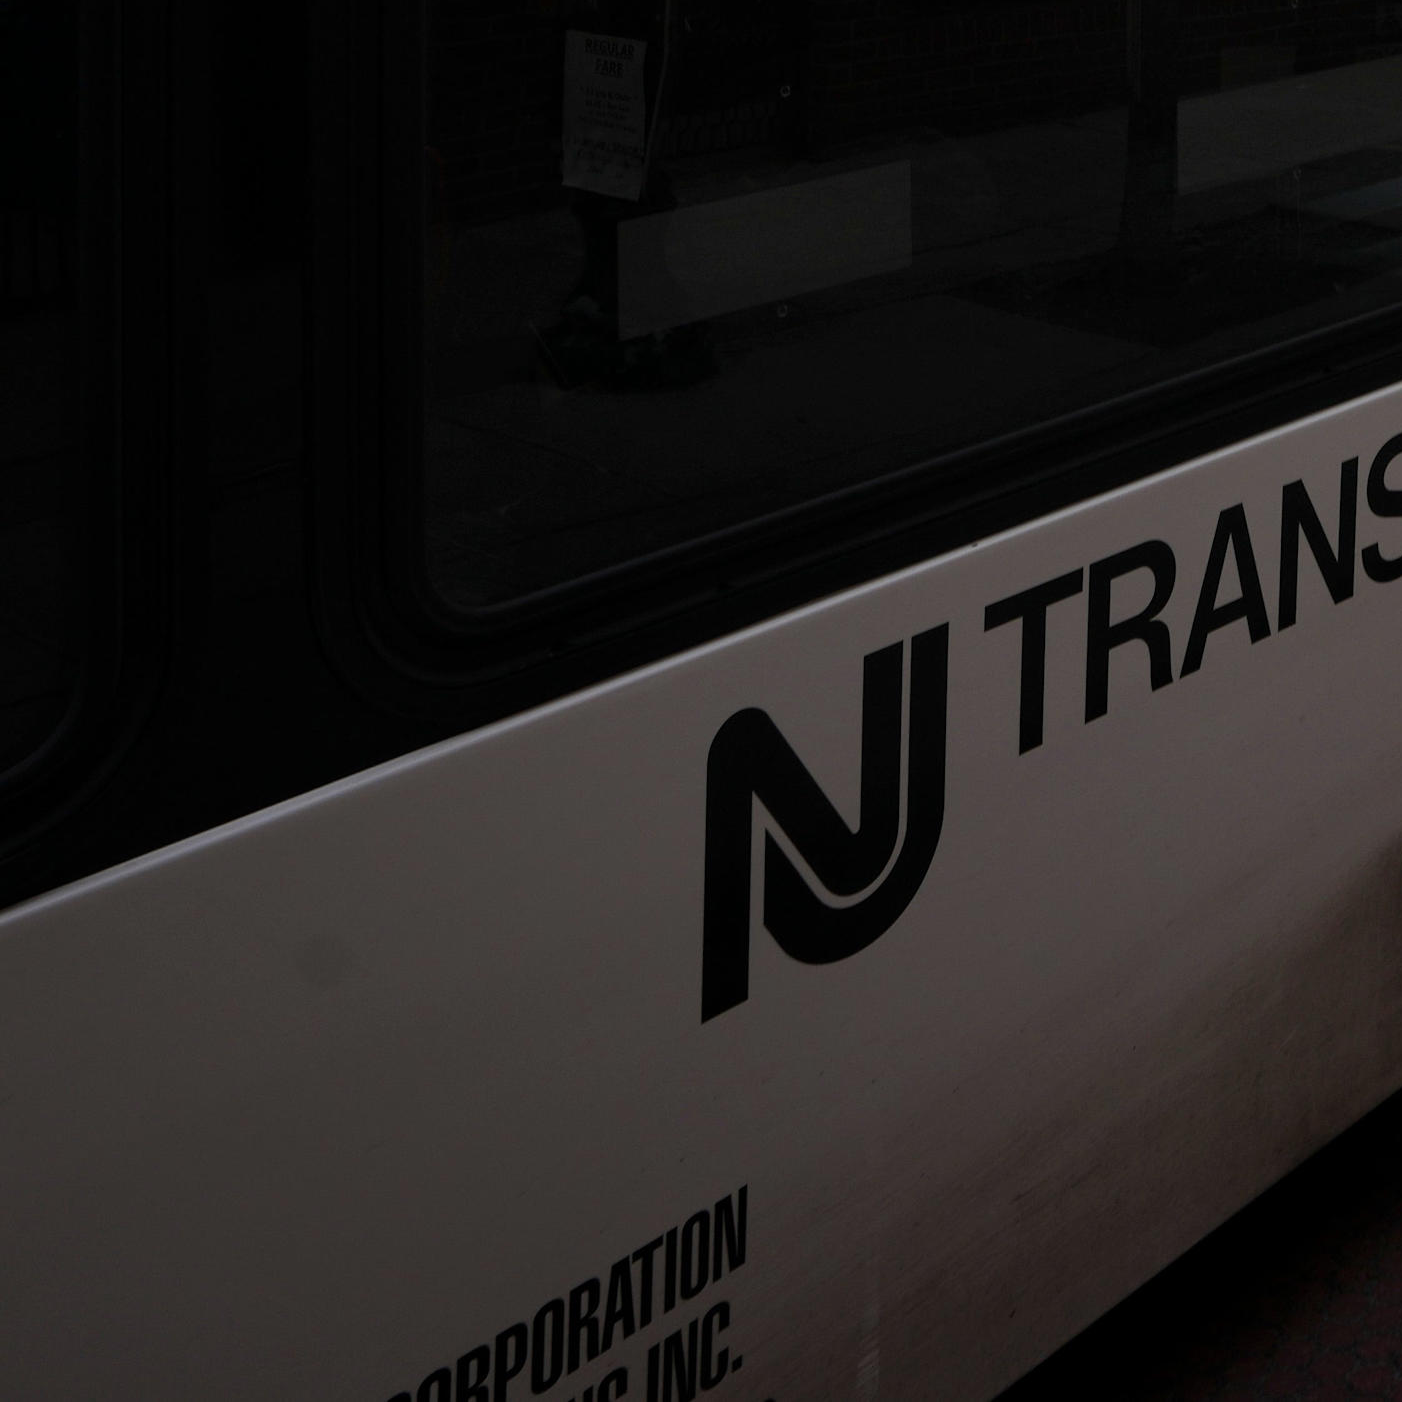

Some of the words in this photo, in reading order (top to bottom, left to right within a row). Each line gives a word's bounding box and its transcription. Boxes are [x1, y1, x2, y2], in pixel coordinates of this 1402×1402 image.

[701, 621, 950, 1025] NJ
[387, 1183, 749, 1402] RPORATION
[646, 1301, 743, 1402] INC.
